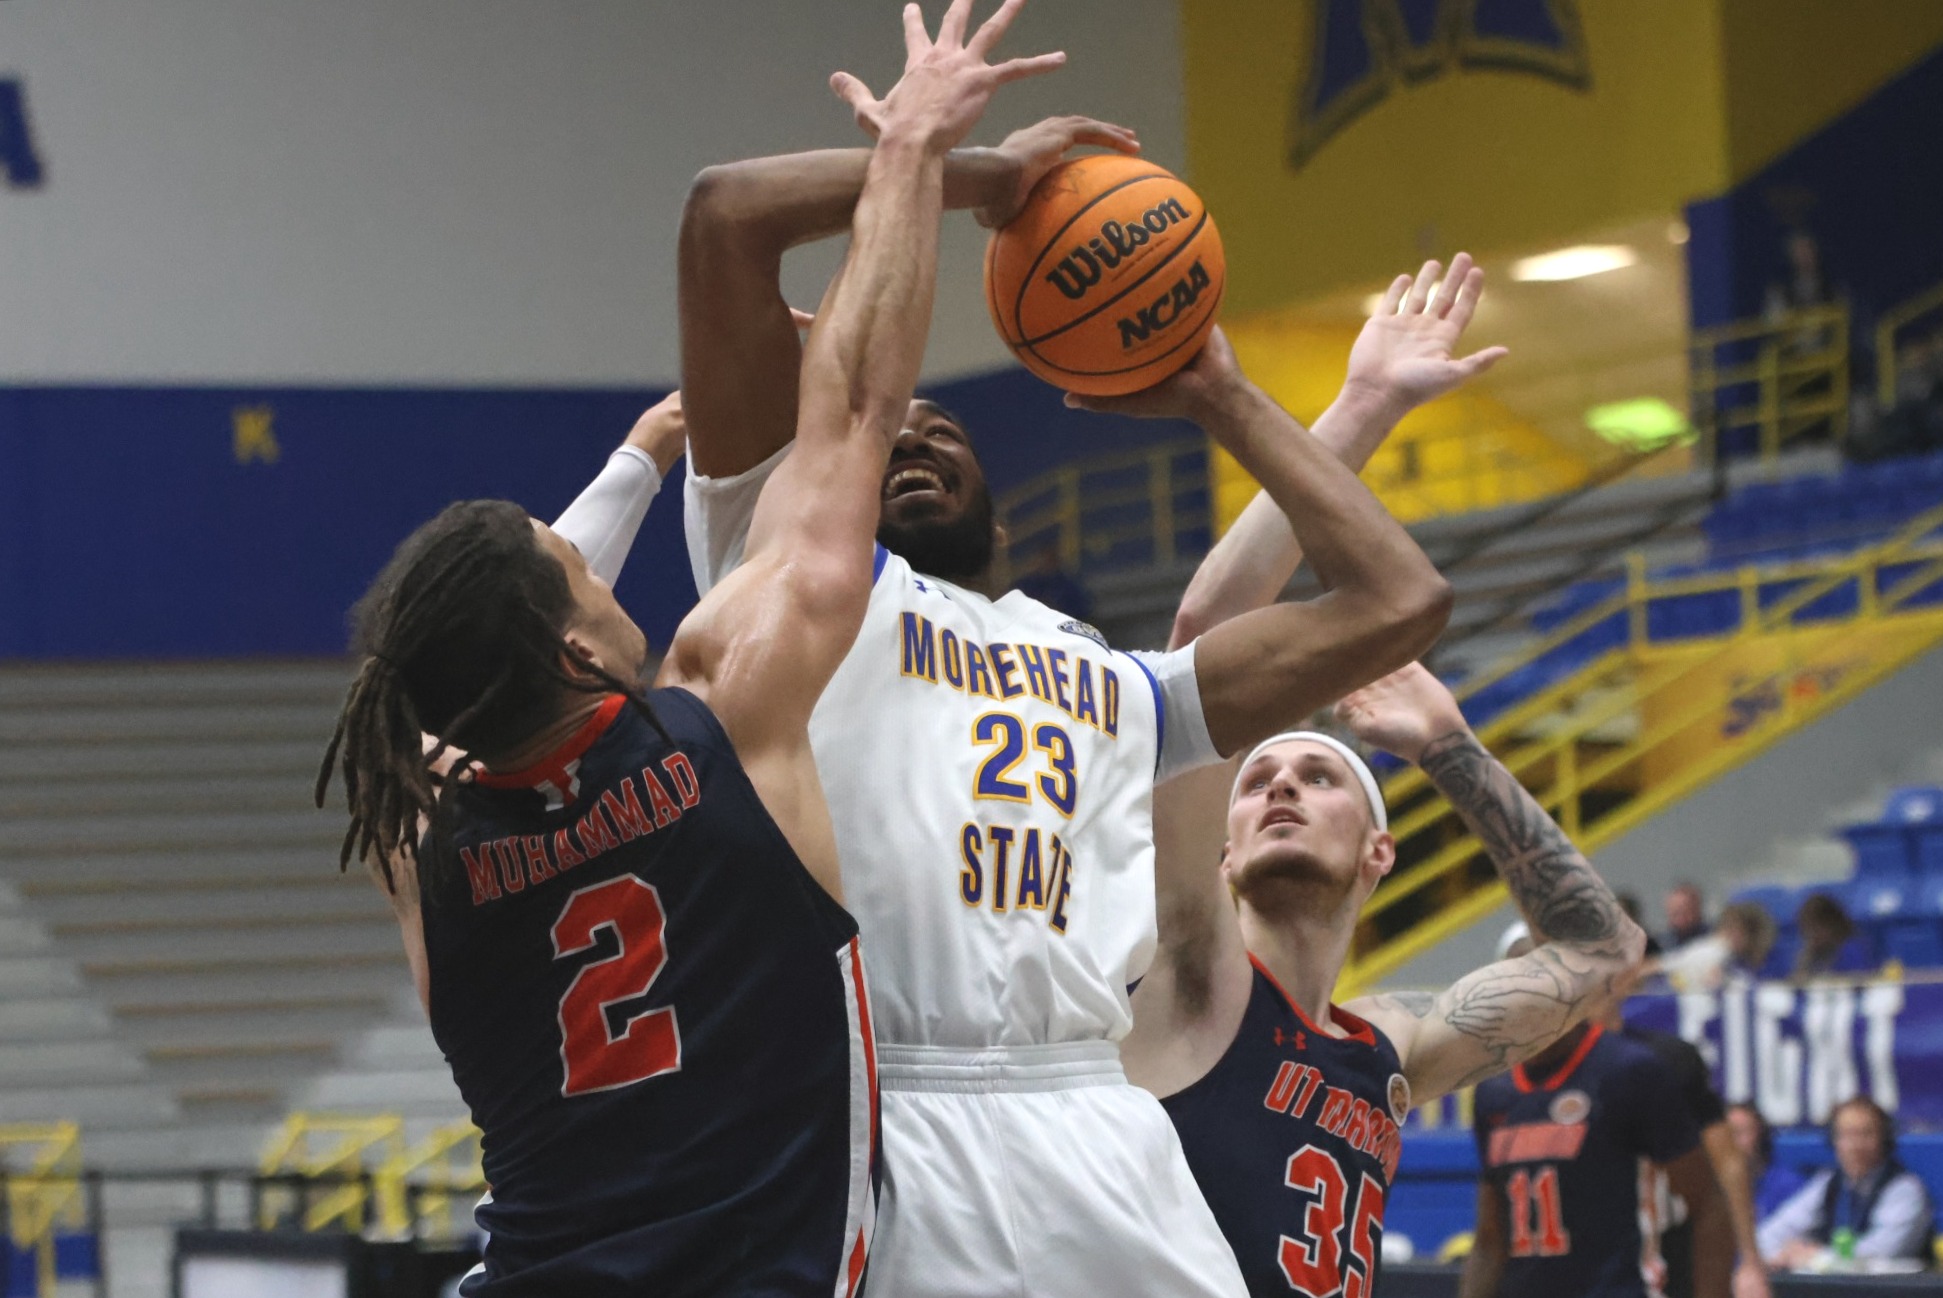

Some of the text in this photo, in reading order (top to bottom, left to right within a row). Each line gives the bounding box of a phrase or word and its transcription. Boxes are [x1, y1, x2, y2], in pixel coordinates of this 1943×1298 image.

[1045, 197, 1191, 300] Wilson
[1116, 260, 1211, 350] NCAA
[230, 402, 281, 465] K
[899, 611, 1120, 741] MOREHEAD
[970, 710, 1079, 821] 23
[459, 750, 702, 907] MUHAMMAD
[958, 821, 1074, 936] STATE
[549, 871, 683, 1099] 2
[1263, 1060, 1325, 1119] UT
[1507, 1166, 1571, 1258] 11
